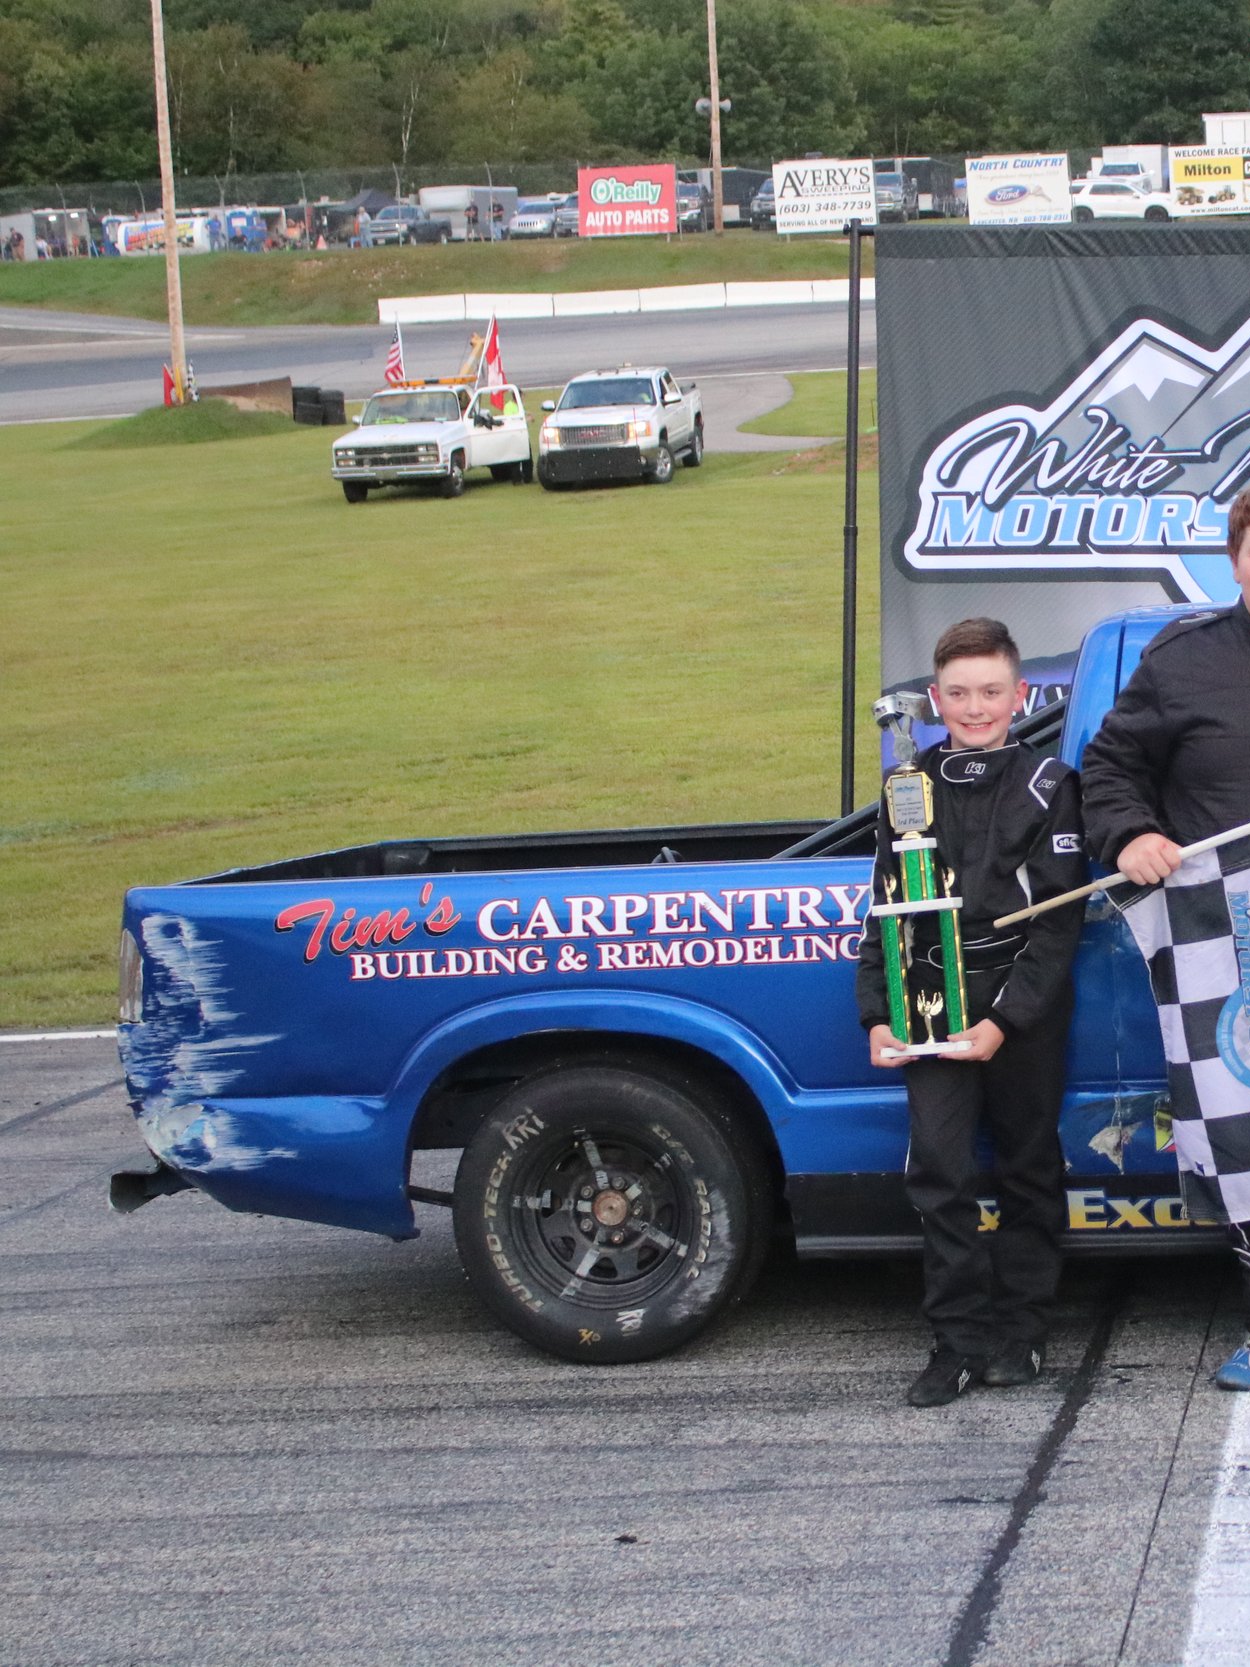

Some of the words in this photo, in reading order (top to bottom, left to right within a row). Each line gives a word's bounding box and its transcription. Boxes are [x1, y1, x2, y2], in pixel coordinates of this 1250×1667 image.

[1174, 149, 1216, 158] WELCOME
[1217, 147, 1239, 155] RACE
[969, 160, 1009, 172] NORTH
[1012, 157, 1066, 169] COUNTRY
[1184, 164, 1231, 176] Milton
[591, 177, 661, 205] O'Reilly
[778, 166, 871, 198] AVERY'S
[995, 190, 1020, 201] Ford
[779, 203, 811, 215] (603)
[815, 200, 872, 213] 348-7739
[585, 210, 622, 227] AUTO
[625, 208, 669, 225] PARTS
[779, 220, 806, 228] SERVING
[938, 406, 1201, 512] White
[274, 881, 462, 964] Tim's
[477, 884, 871, 942] CARPENTRY
[349, 945, 548, 981] BUILDING
[557, 943, 588, 972] &
